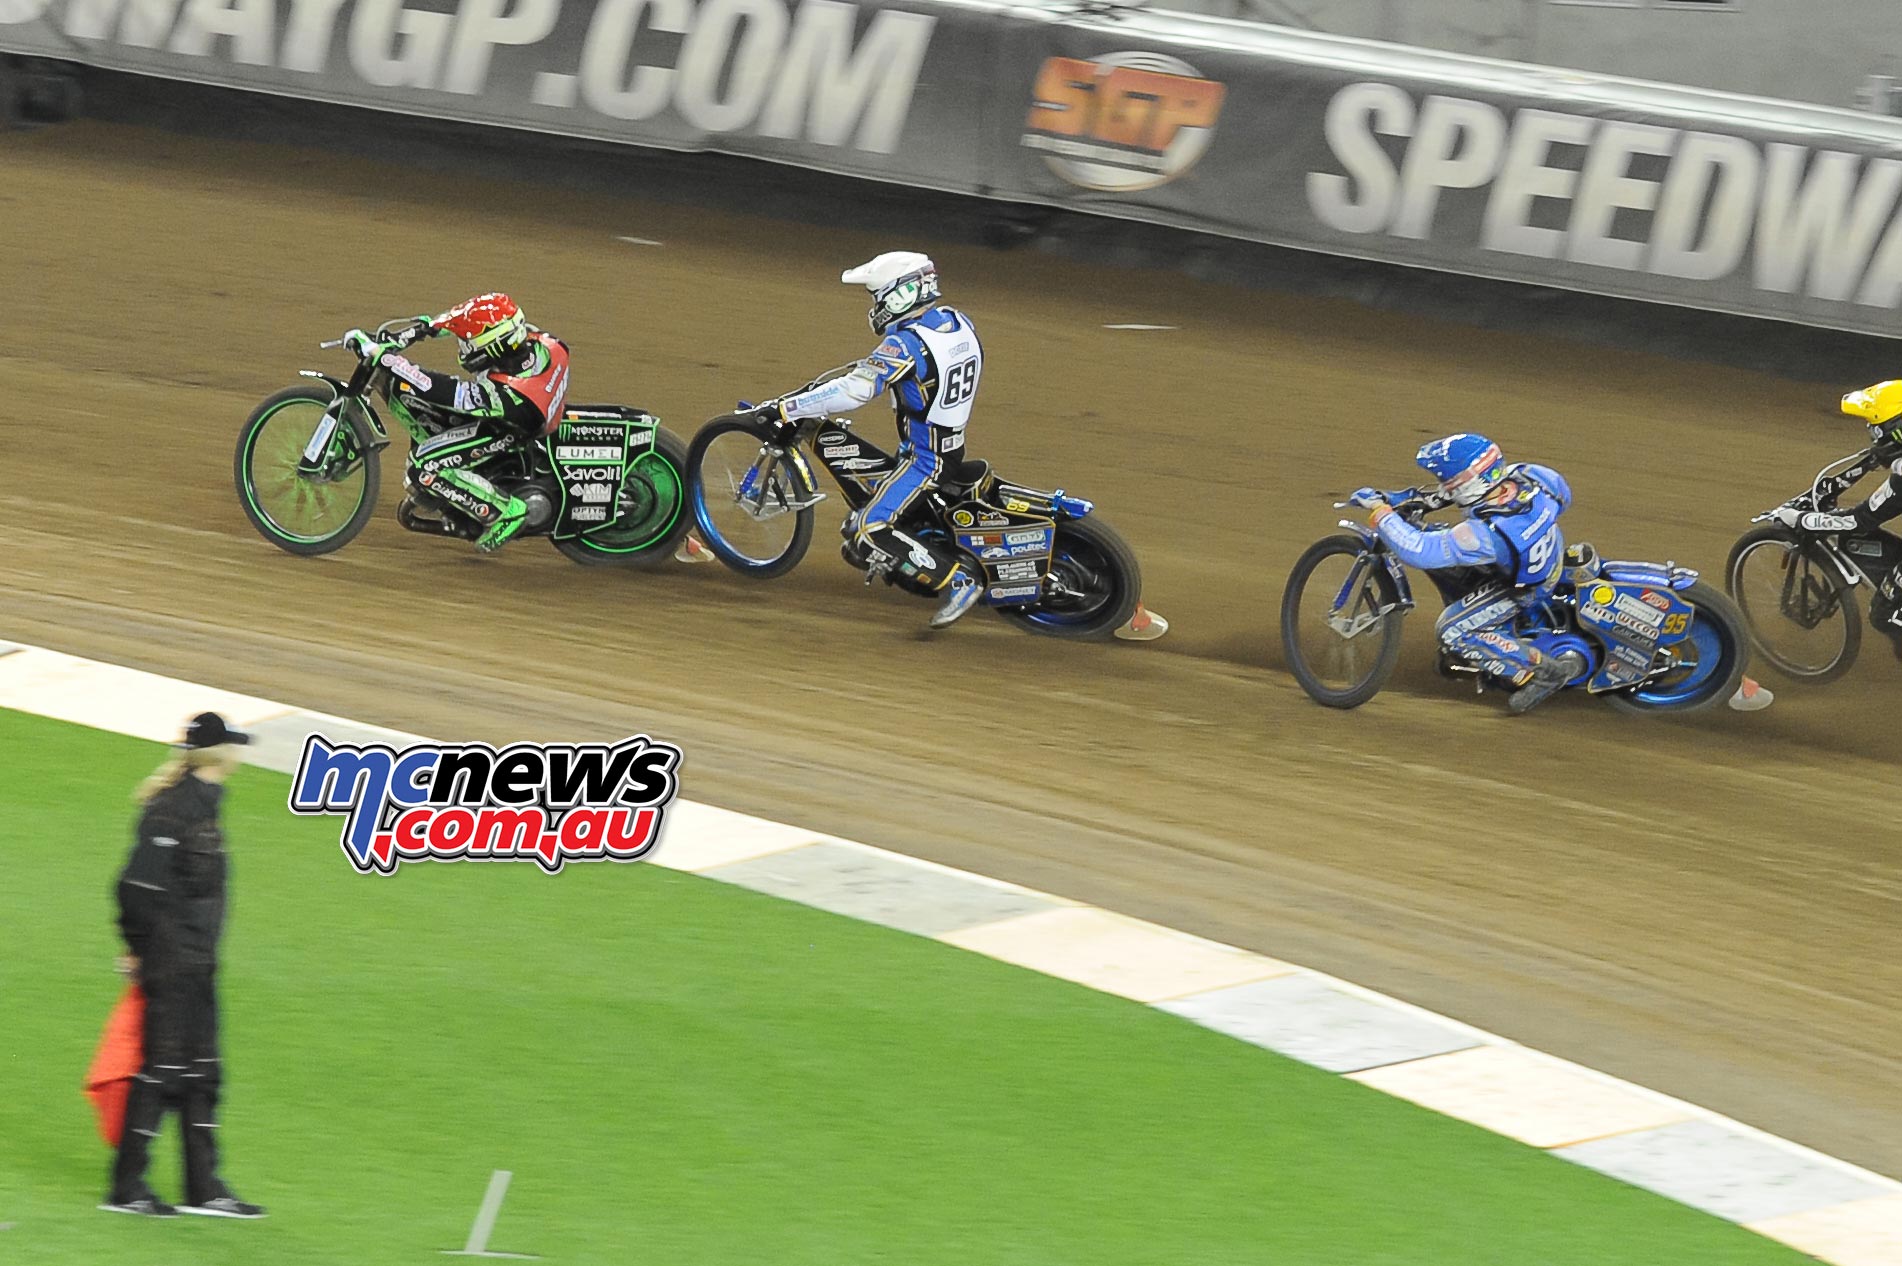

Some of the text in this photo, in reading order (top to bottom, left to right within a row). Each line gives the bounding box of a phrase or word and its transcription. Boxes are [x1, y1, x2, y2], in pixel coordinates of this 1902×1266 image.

[0, 0, 936, 154] AYGP.COM
[1026, 56, 1228, 152] SGP
[943, 359, 976, 405] 69
[571, 426, 624, 437] MONSTER
[557, 448, 620, 459] LUMEL
[1006, 499, 1031, 512] 69
[1661, 613, 1690, 634] 95
